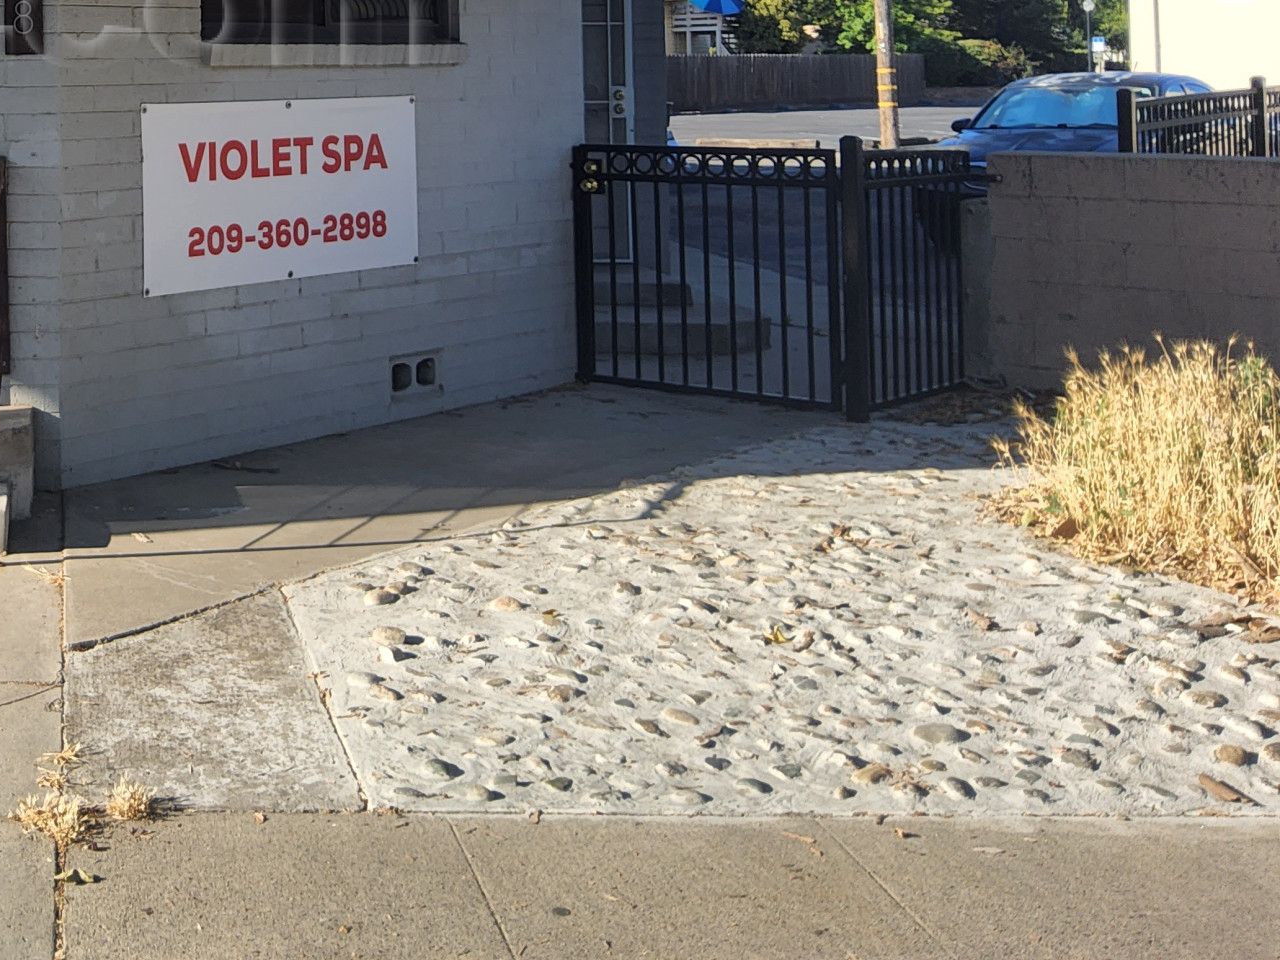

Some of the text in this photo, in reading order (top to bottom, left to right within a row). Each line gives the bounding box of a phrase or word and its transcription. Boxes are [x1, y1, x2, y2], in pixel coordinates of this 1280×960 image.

[178, 133, 388, 183] VIOLET SPA
[188, 209, 387, 257] 209-360-2898
